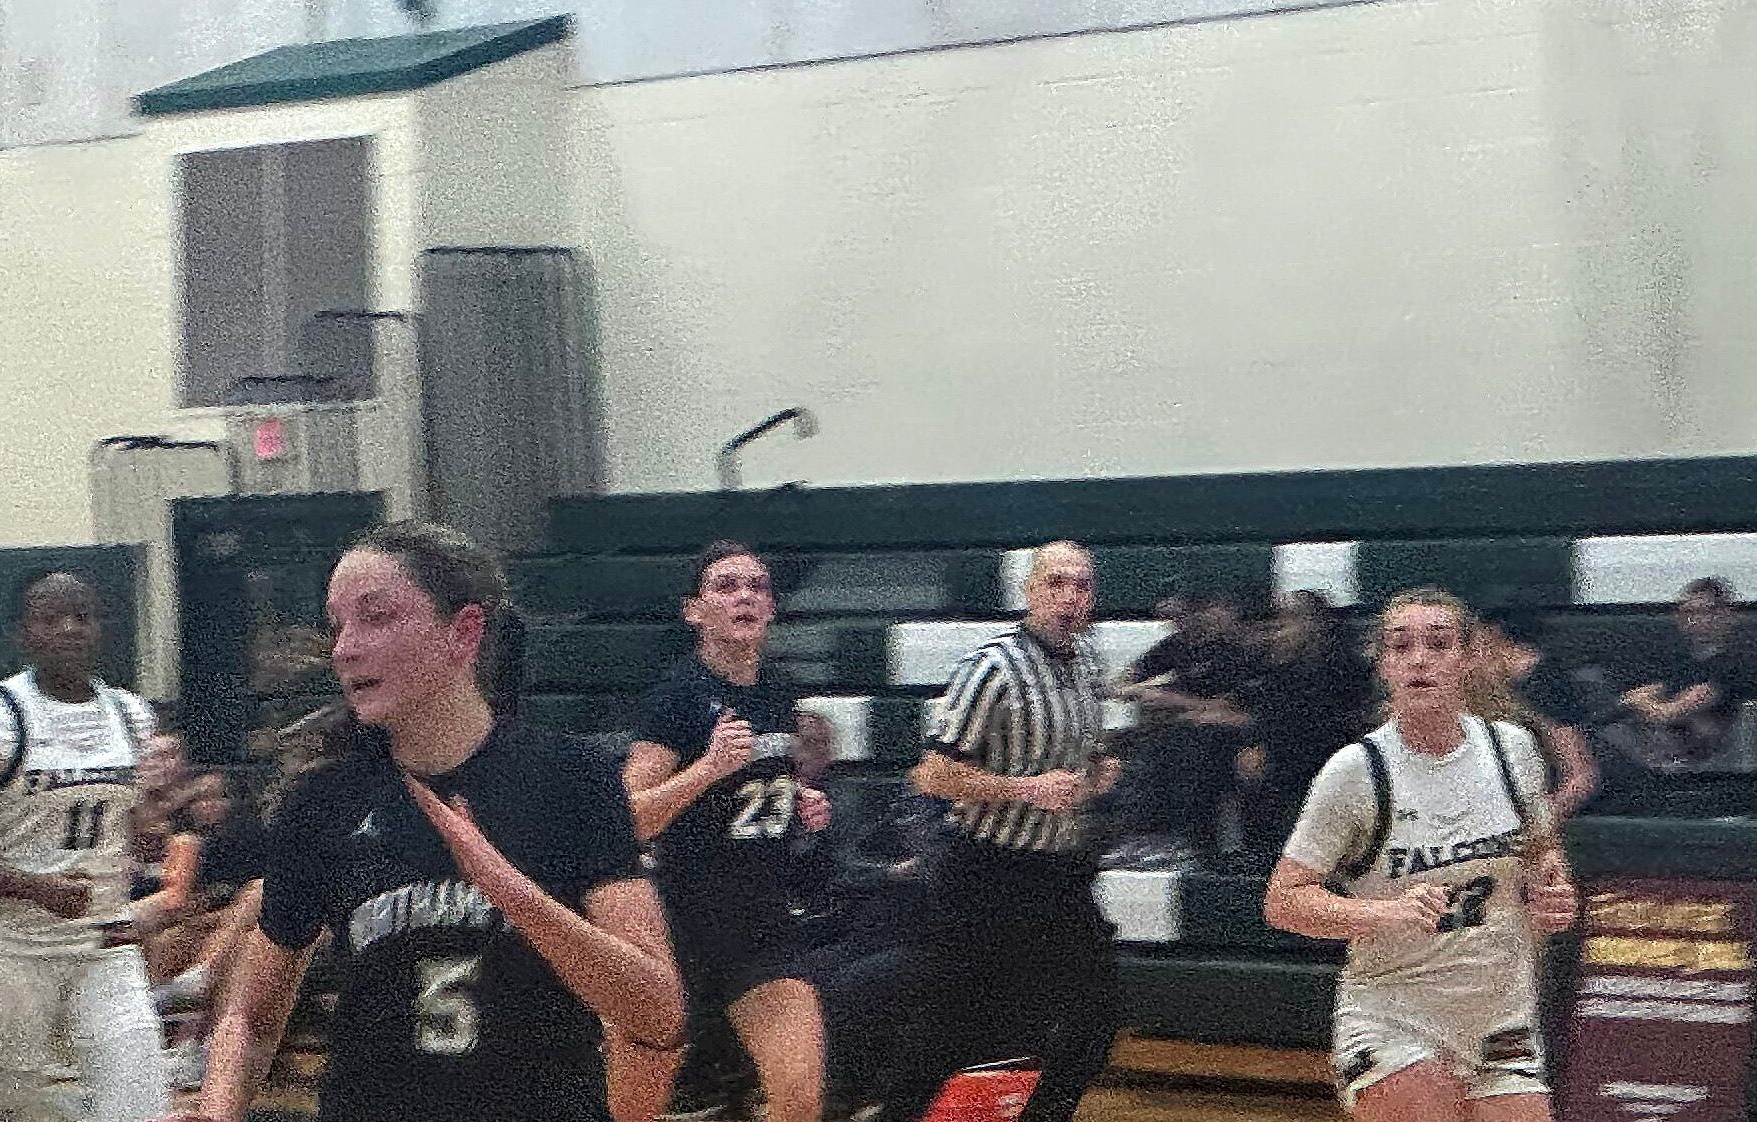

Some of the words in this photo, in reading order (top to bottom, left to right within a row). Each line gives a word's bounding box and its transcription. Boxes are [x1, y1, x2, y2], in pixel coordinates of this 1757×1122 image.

[65, 799, 108, 851] 11
[729, 774, 794, 840] 23
[413, 953, 484, 1055] 5
